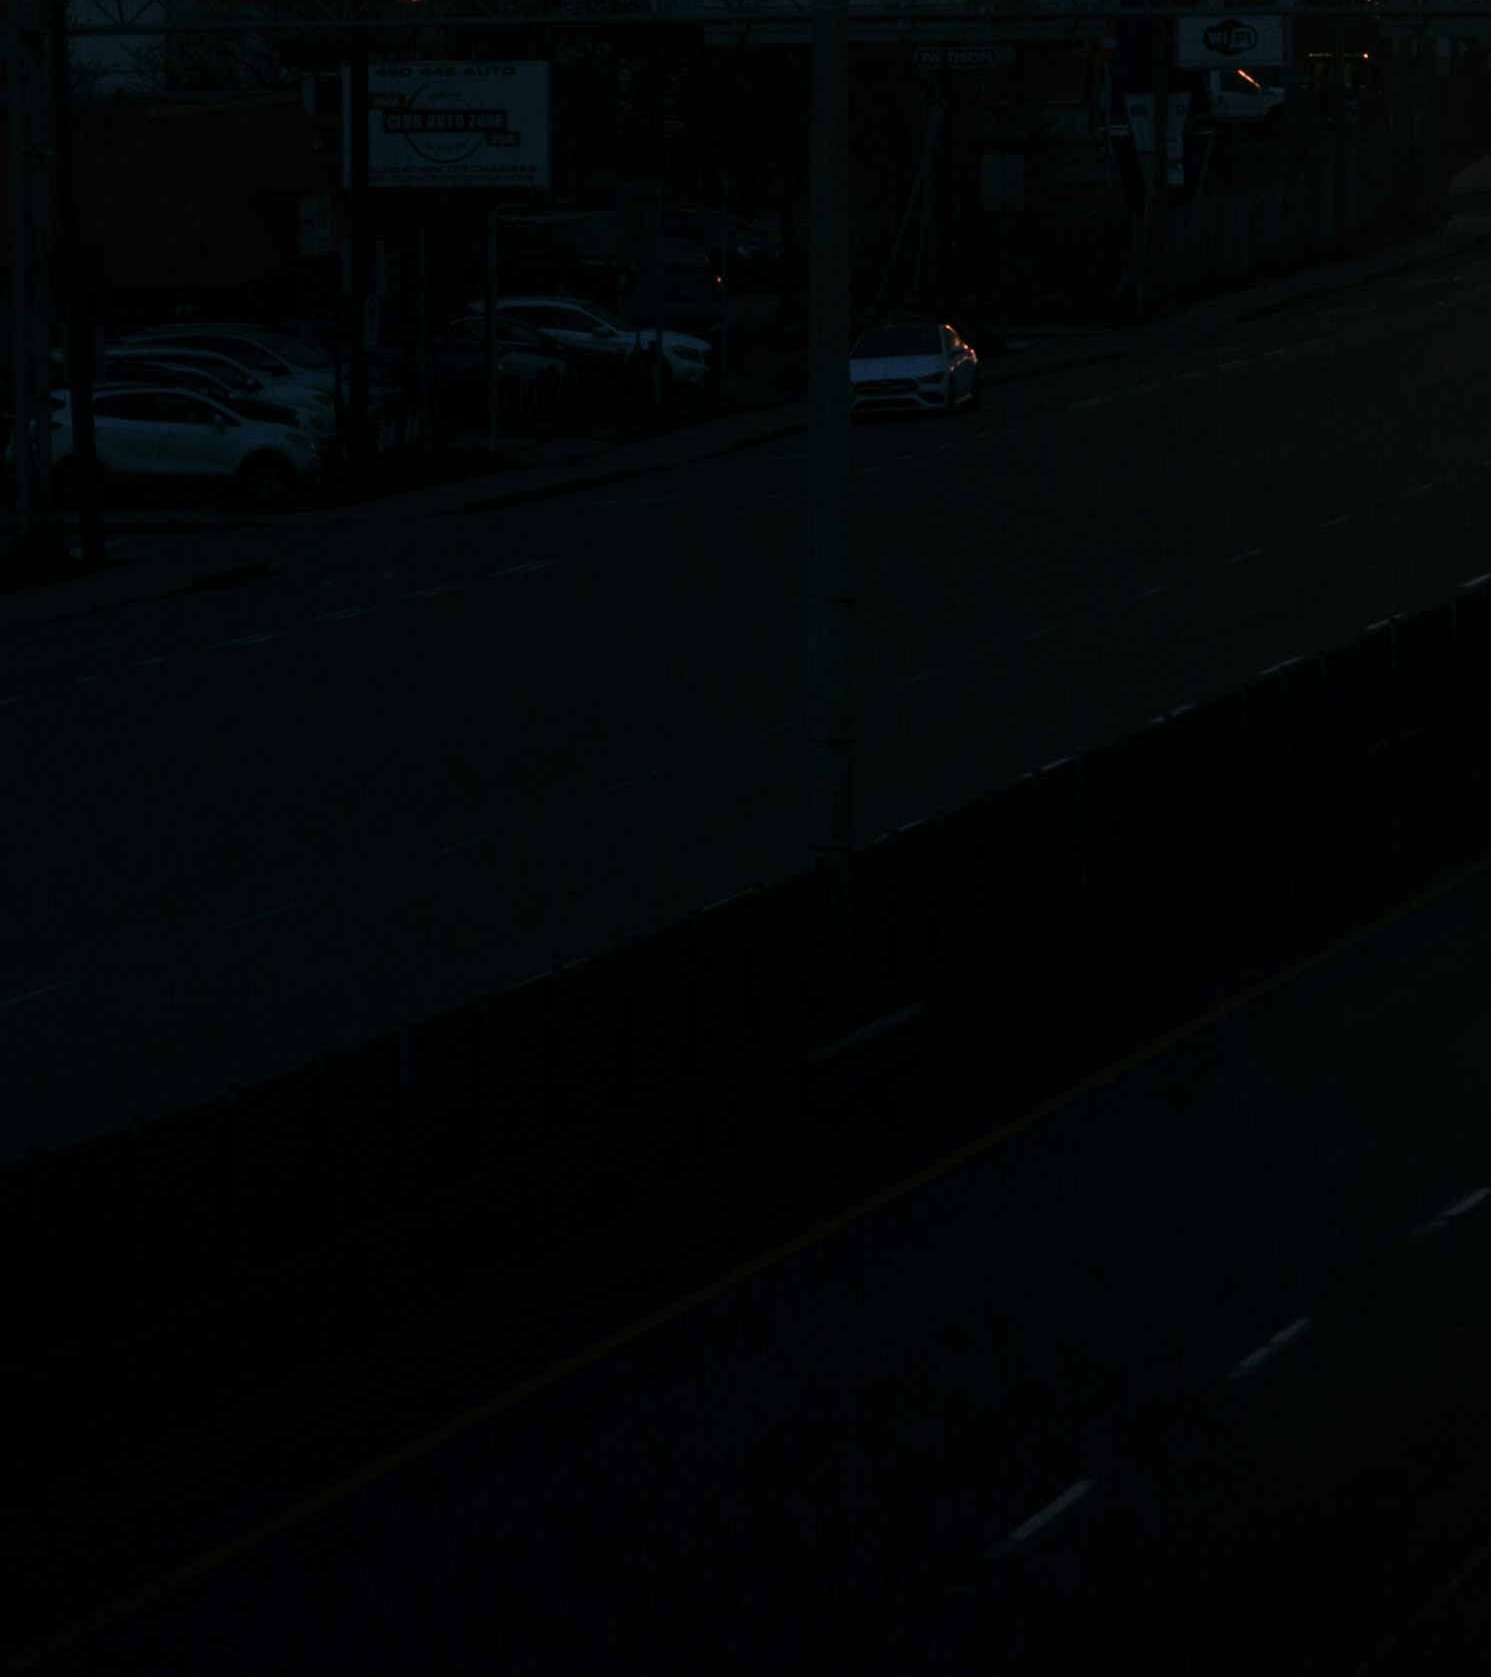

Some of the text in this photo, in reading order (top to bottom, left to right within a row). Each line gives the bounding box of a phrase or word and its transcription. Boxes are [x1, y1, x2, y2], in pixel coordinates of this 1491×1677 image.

[921, 51, 992, 64] PATISON
[419, 66, 516, 76] 442-AUTO
[386, 113, 503, 129] CLUB AUTO ZONE
[390, 174, 535, 183] CONCESSIONNAIRES
